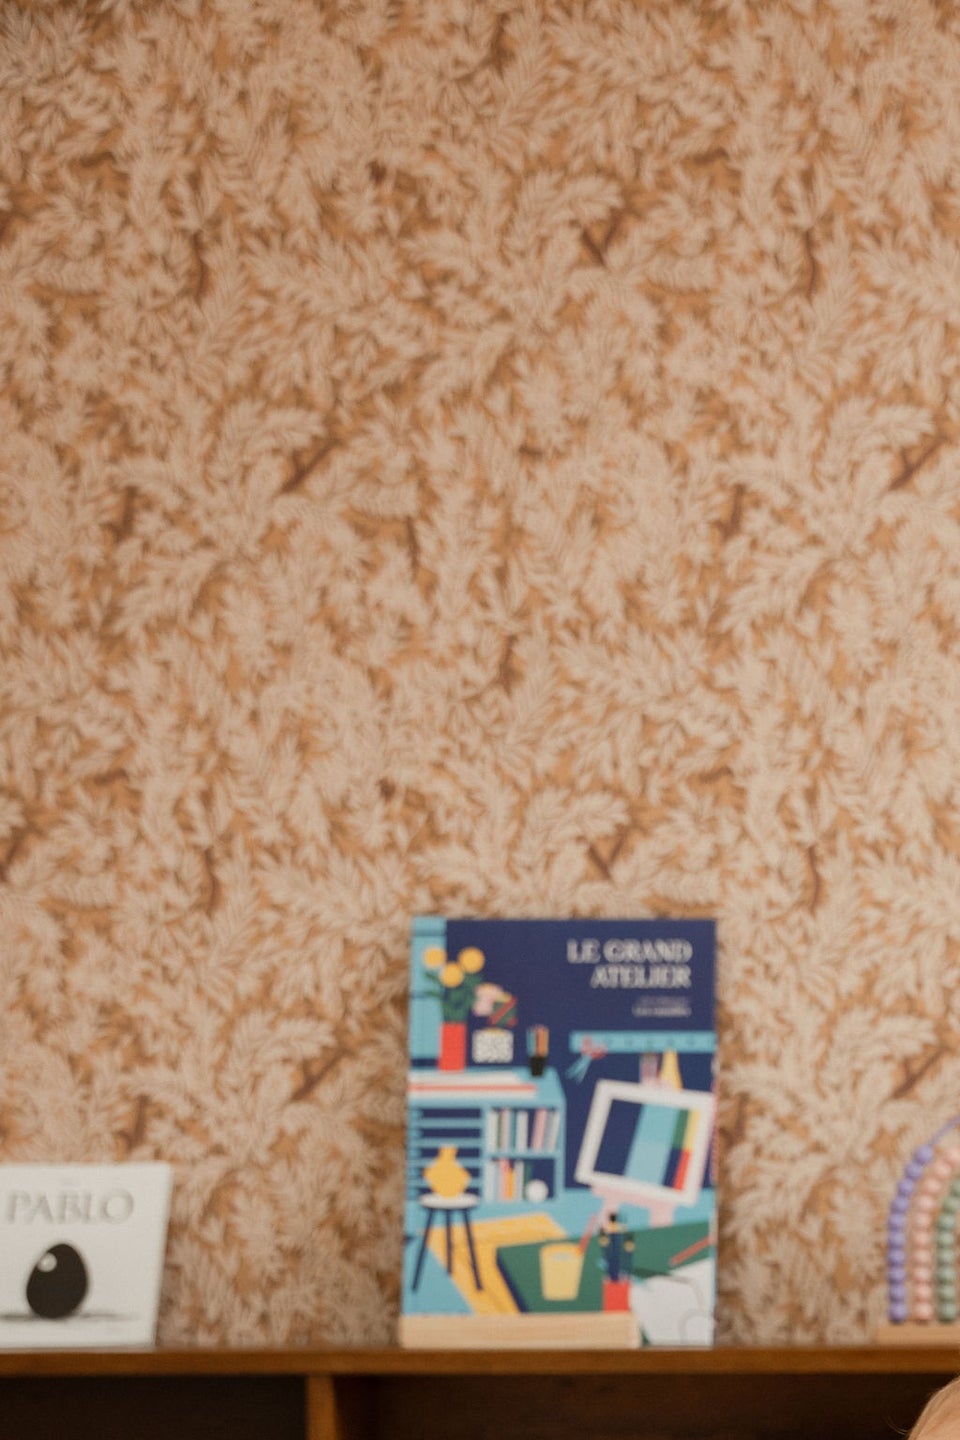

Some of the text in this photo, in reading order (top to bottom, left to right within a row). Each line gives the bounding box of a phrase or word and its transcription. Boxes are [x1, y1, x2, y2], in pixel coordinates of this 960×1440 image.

[566, 938, 693, 964] LE GRAND
[590, 963, 692, 989] ATELIER
